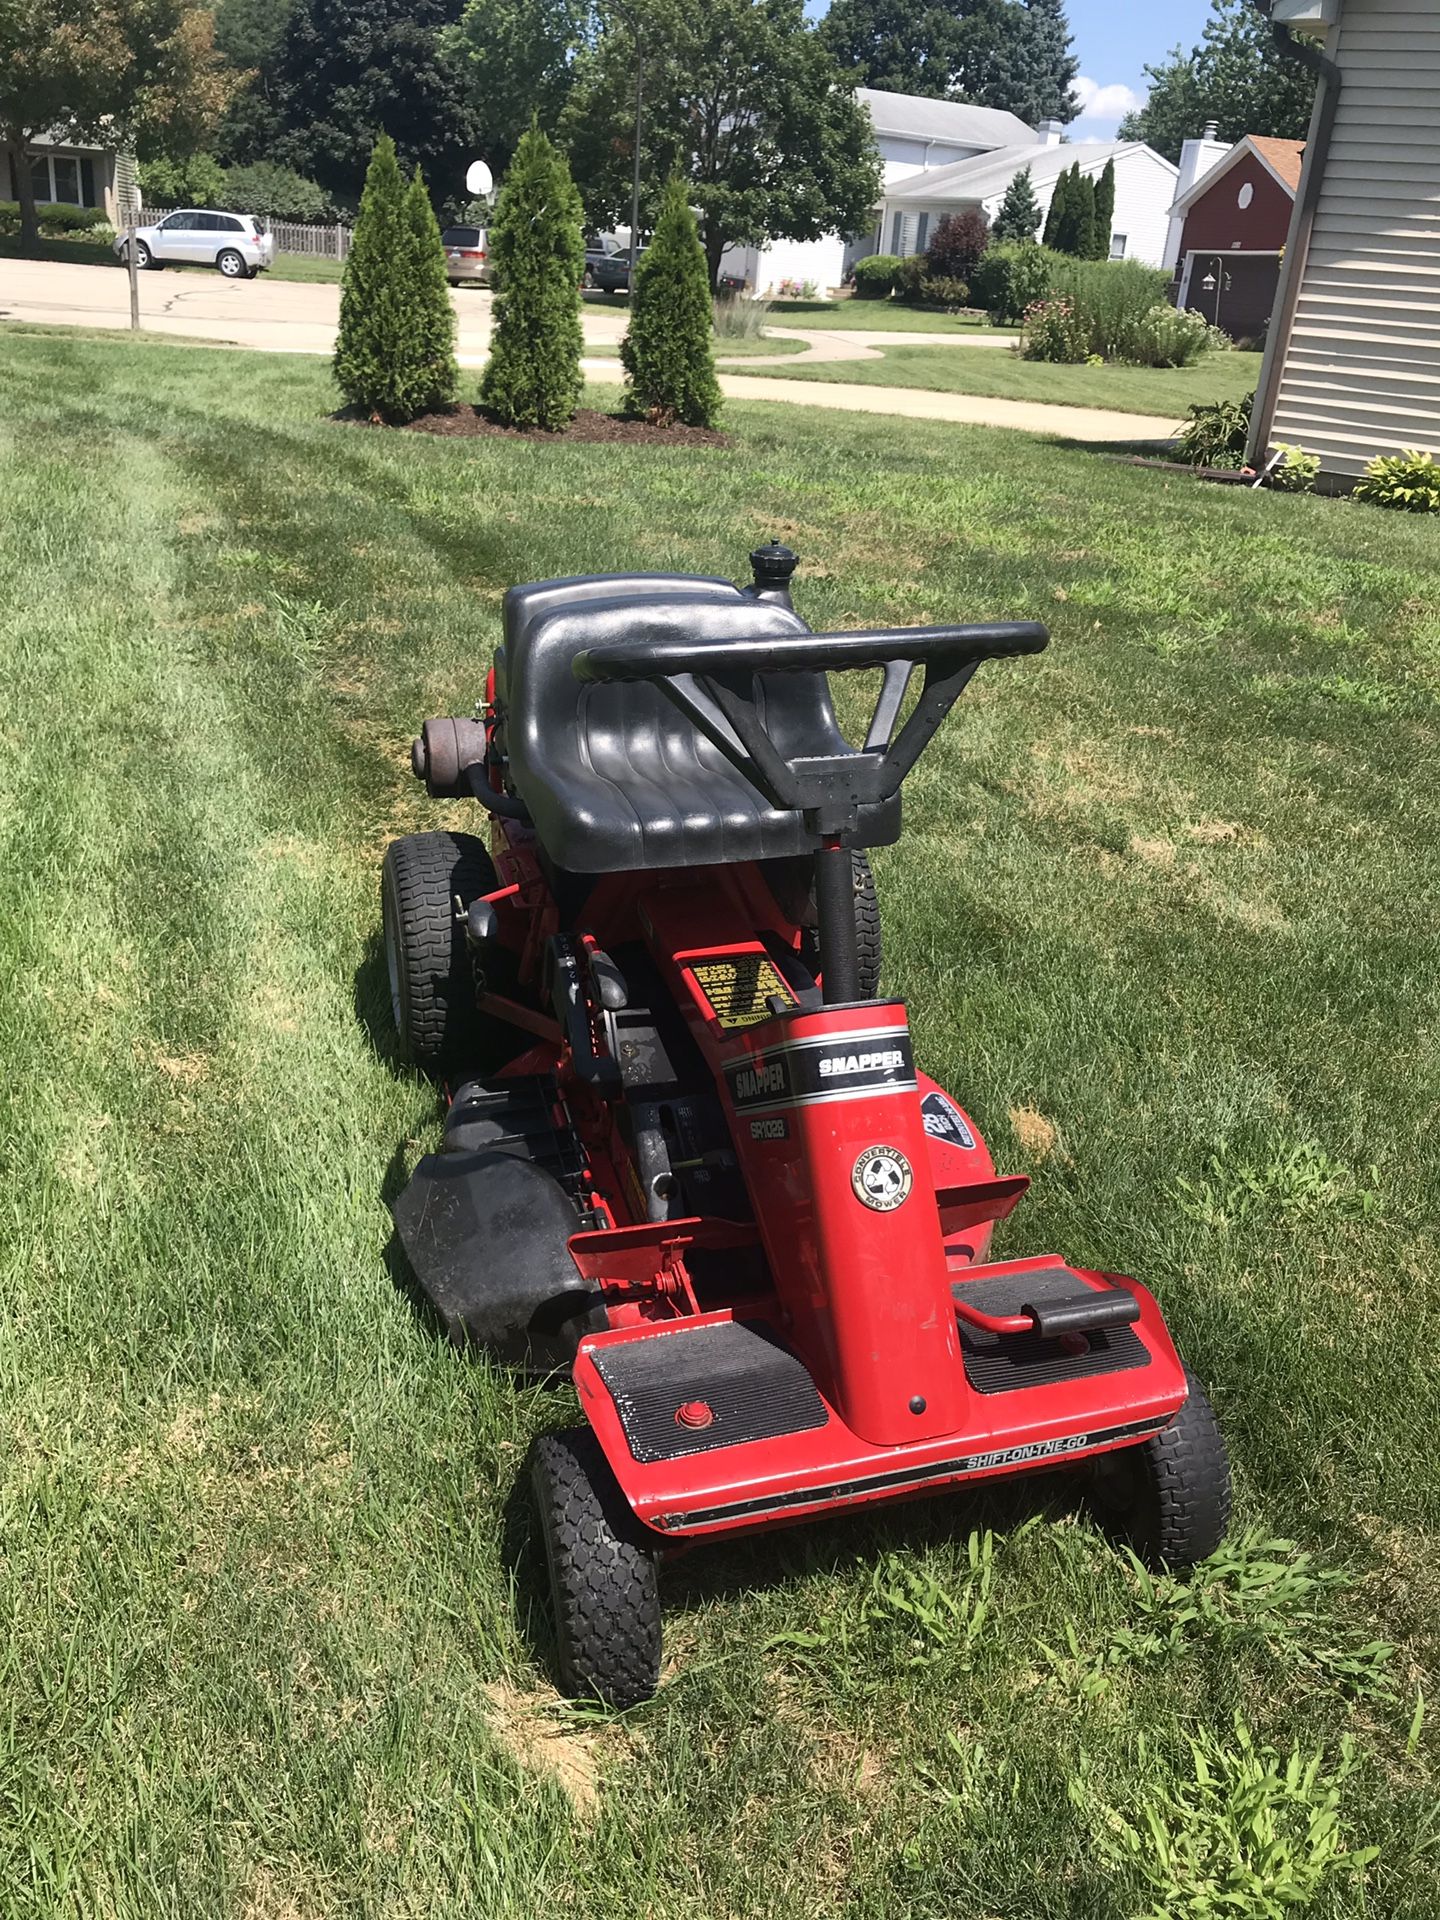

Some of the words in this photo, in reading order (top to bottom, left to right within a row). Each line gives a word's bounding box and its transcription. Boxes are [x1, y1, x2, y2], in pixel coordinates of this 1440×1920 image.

[819, 1050, 904, 1077] SNAPPER
[736, 1062, 785, 1099] SNAPPER
[751, 1118, 785, 1139] SR1028
[922, 1113, 947, 1134] 28
[854, 1148, 911, 1183] CONVERTIBLE
[865, 1191, 906, 1208] MOWER
[966, 1435, 1088, 1469] SHIFT-ON-THE-GO
